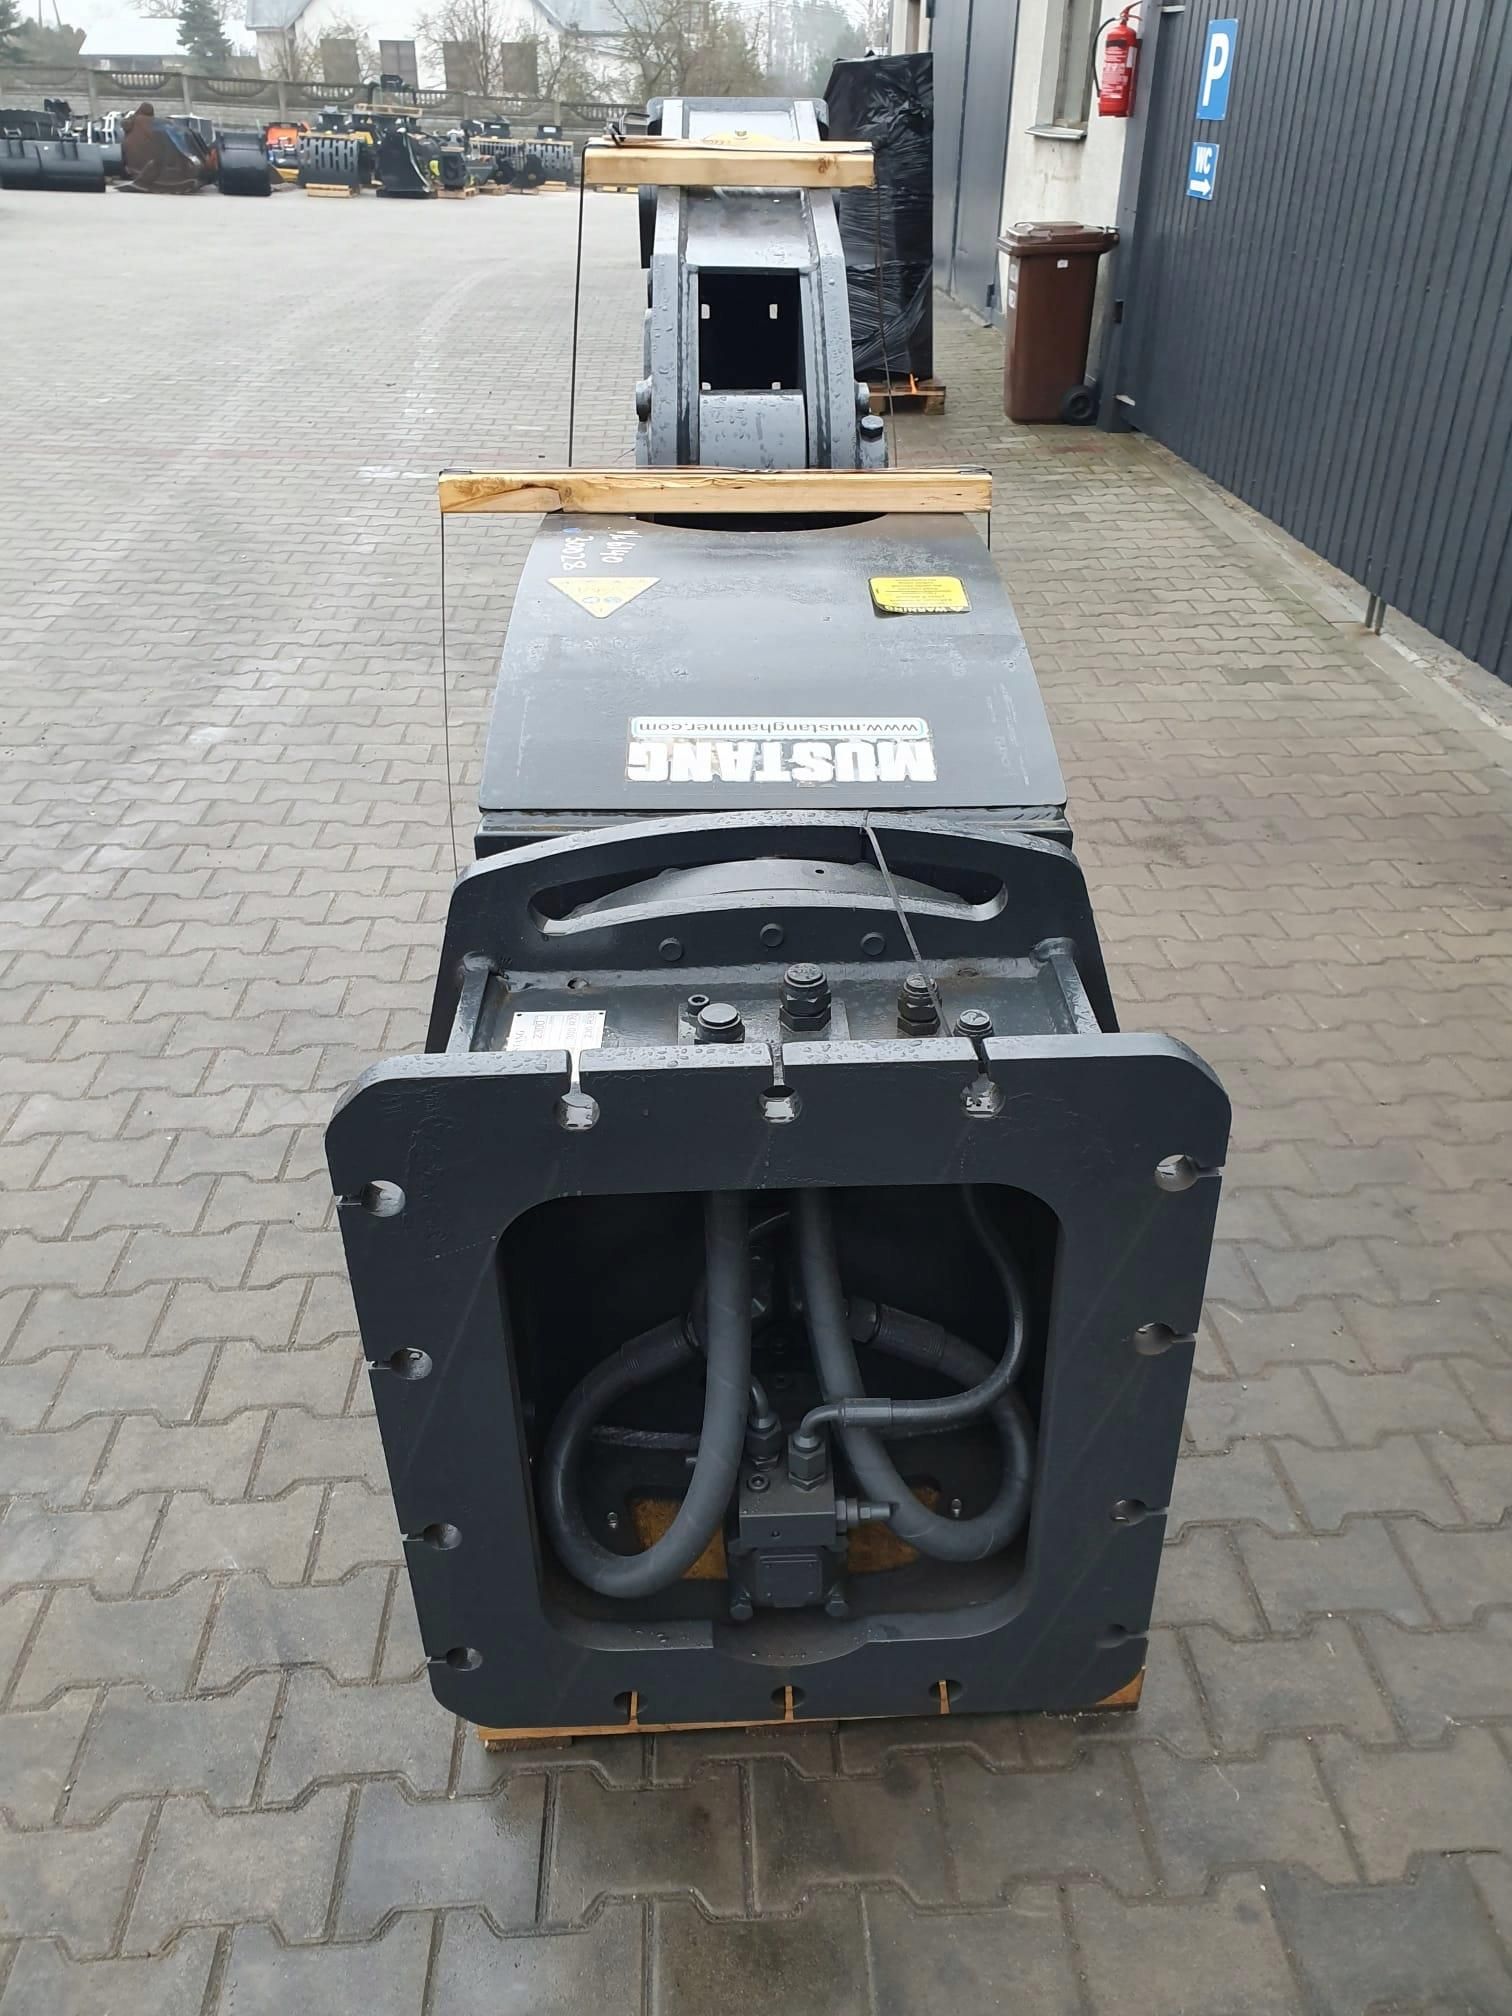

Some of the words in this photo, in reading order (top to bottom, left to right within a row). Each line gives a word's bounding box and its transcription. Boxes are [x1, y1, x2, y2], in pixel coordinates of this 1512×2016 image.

[1203, 32, 1229, 106] P
[1195, 146, 1212, 174] WC
[560, 536, 594, 570] 30028
[884, 605, 947, 613] WARNING
[639, 722, 919, 734] www.mustanghammer.com
[627, 741, 937, 782] MUSTANG
